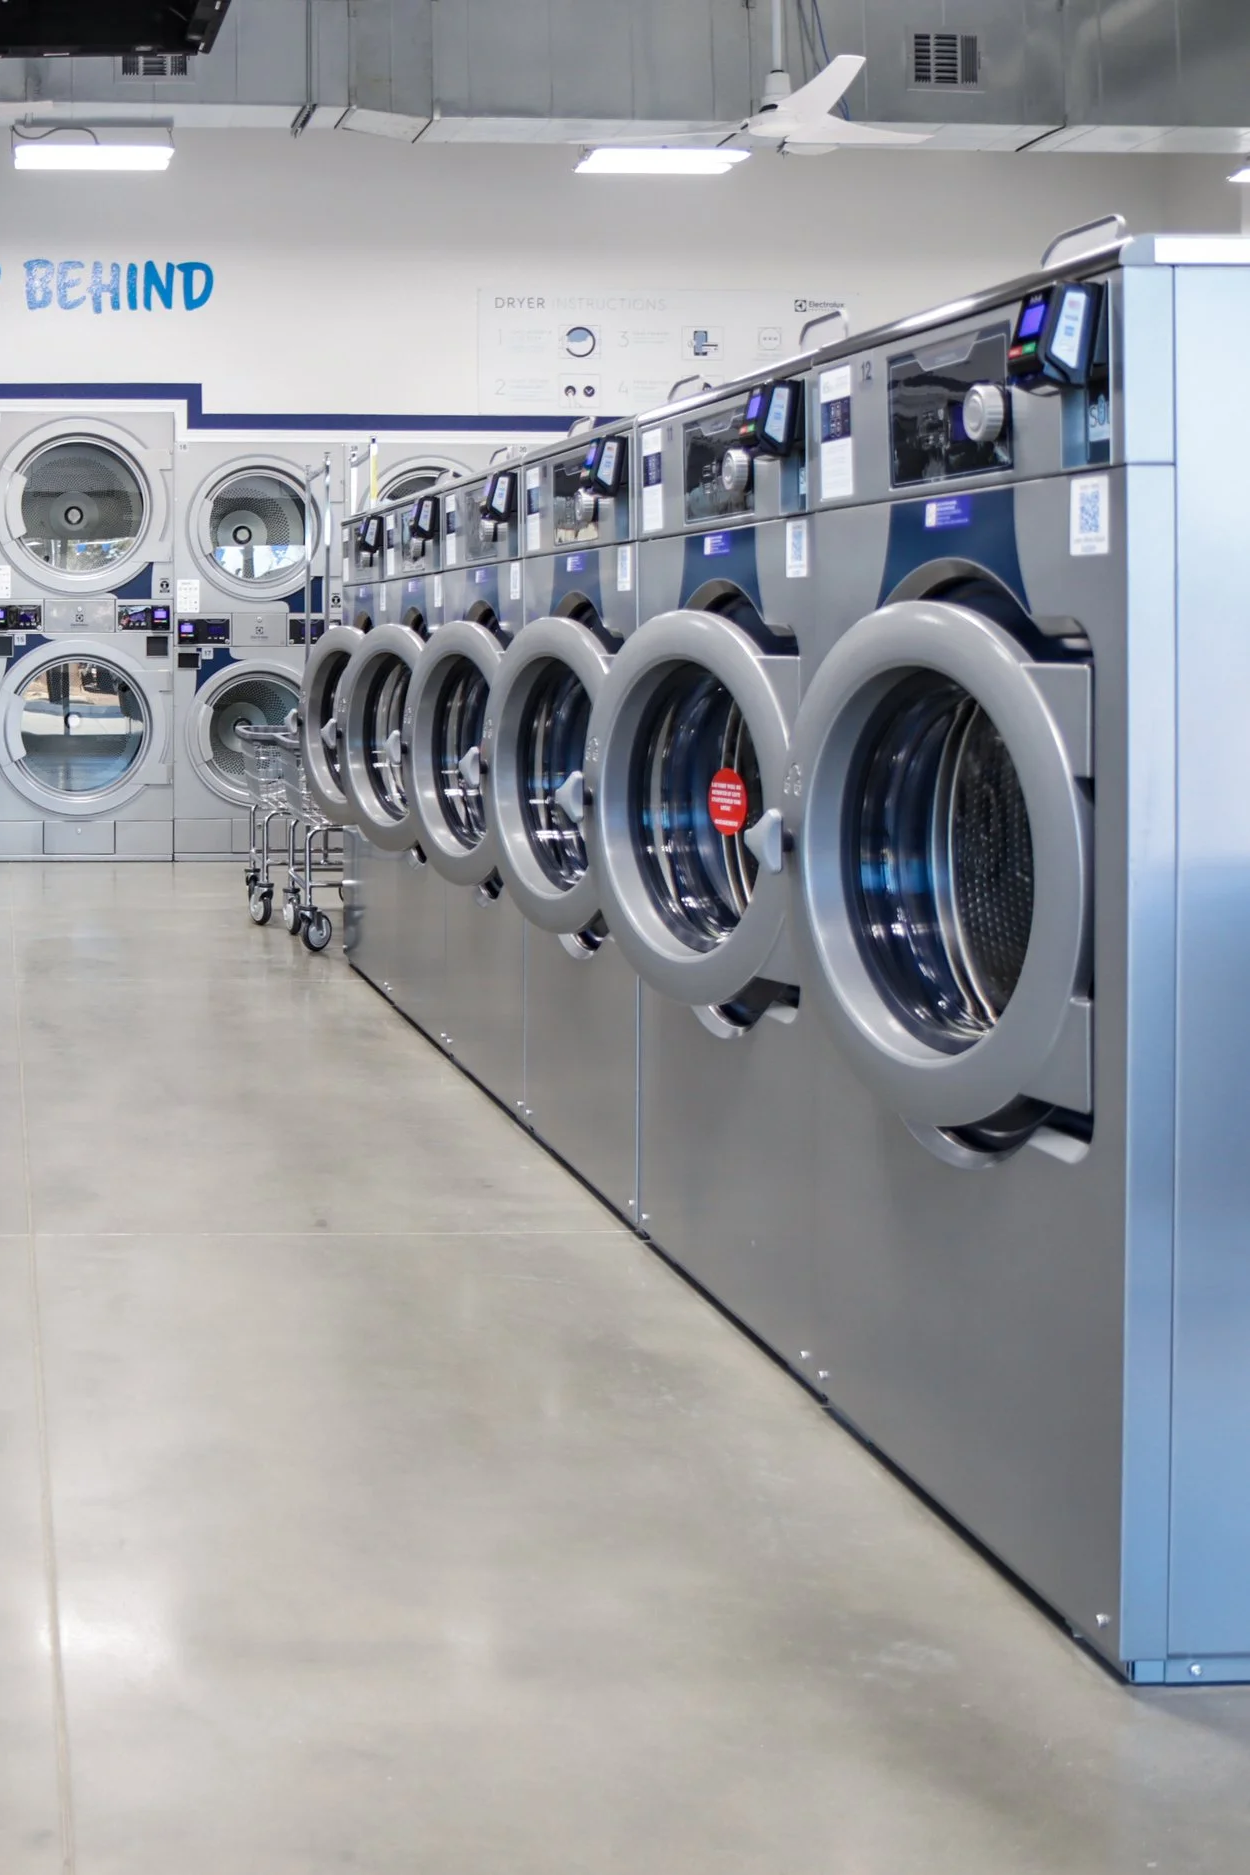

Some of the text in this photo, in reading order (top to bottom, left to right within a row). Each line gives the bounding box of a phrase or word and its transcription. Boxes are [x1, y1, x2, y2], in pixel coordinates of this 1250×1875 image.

[24, 259, 216, 315] BEHIND
[494, 296, 667, 311] DRYER INSTRUCTIONS
[617, 330, 630, 348] 3
[861, 361, 872, 380] 12
[494, 378, 506, 396] 2
